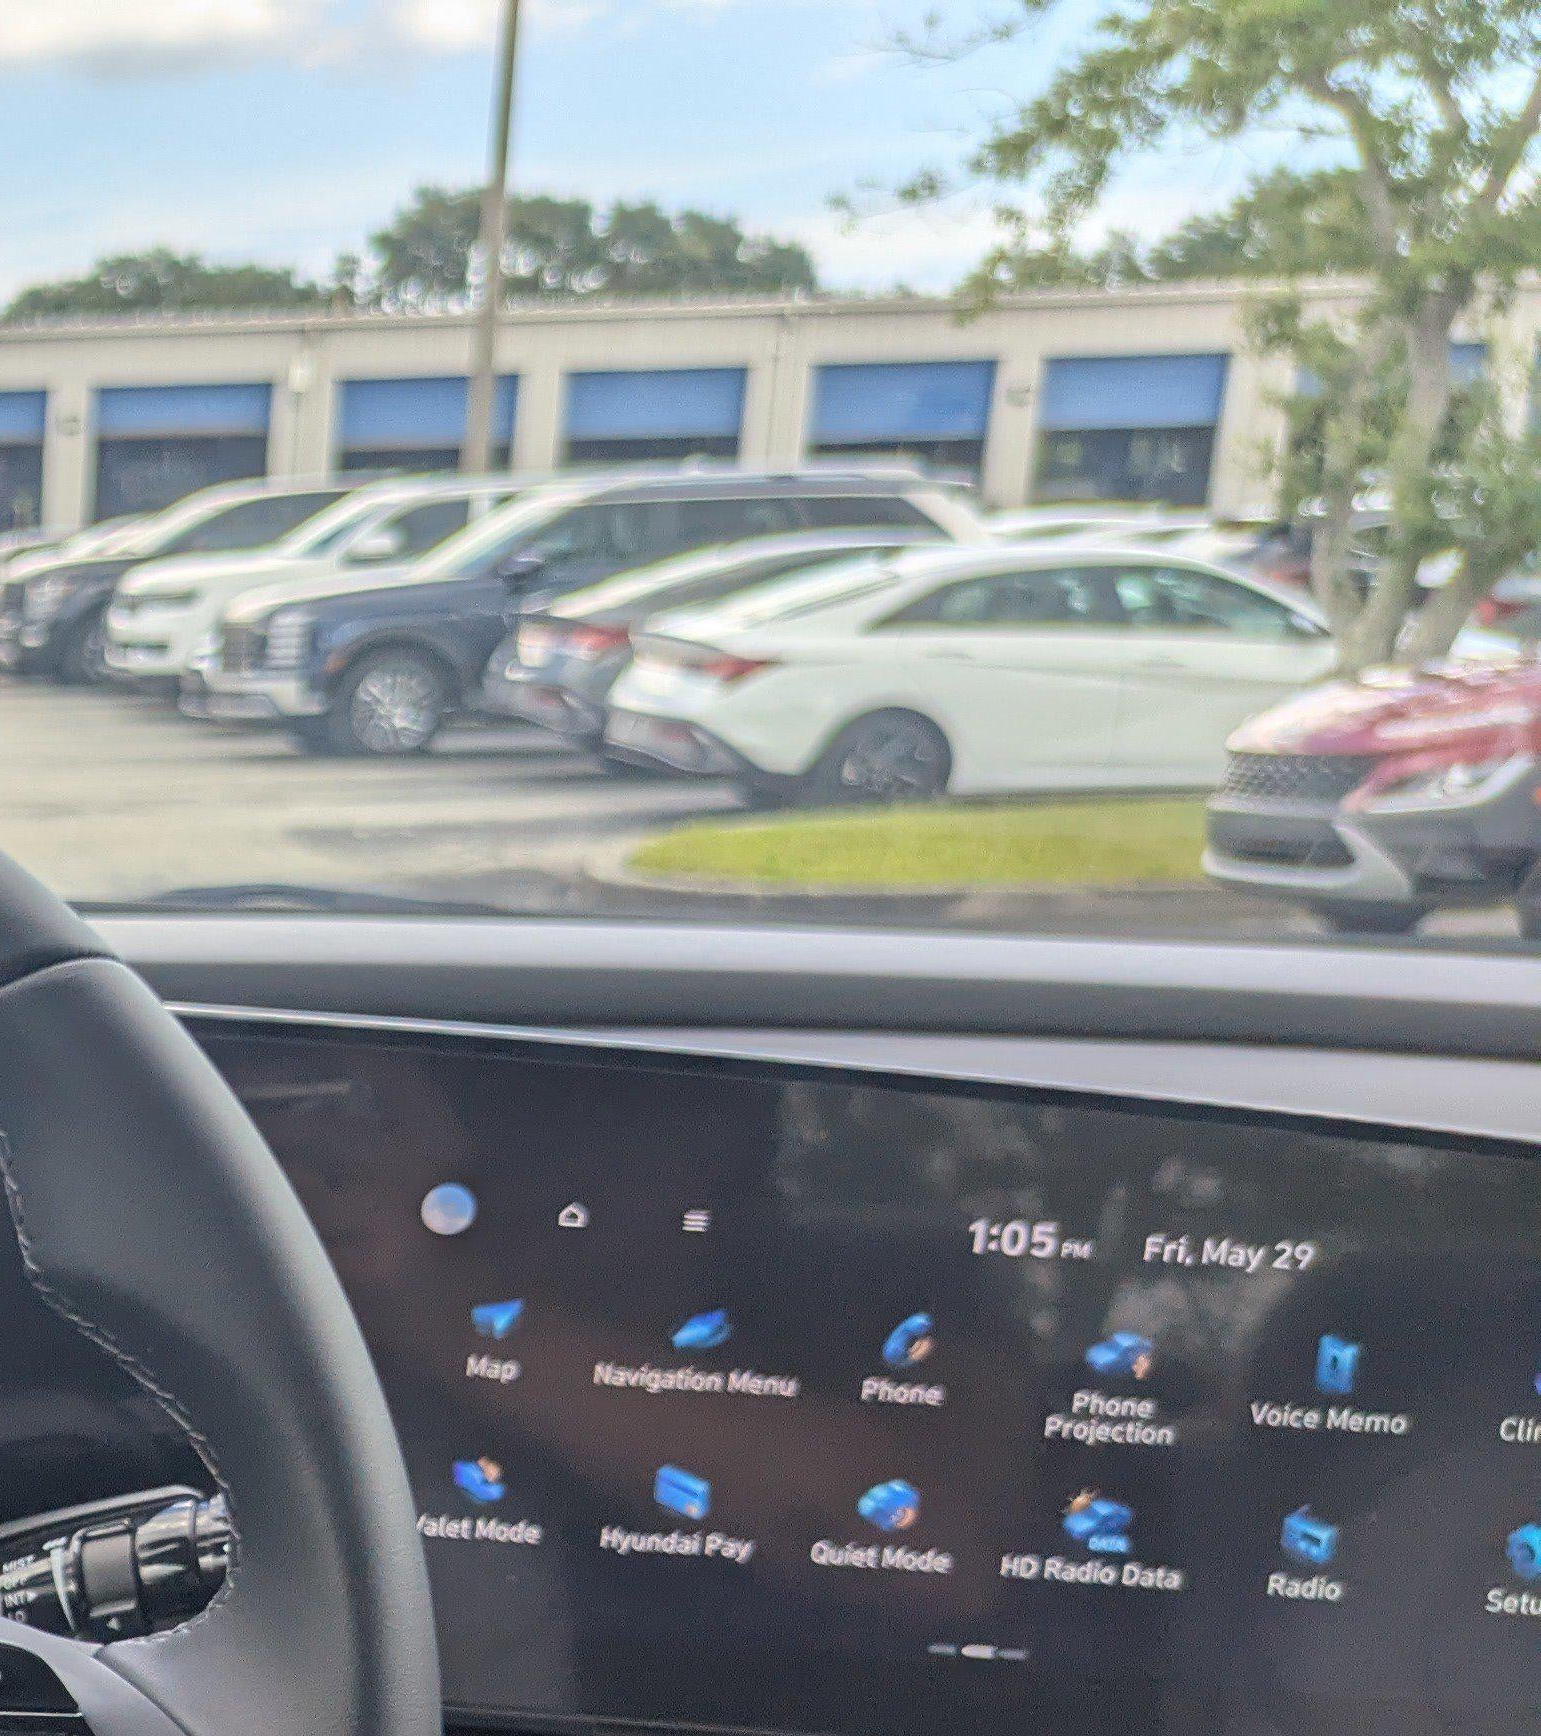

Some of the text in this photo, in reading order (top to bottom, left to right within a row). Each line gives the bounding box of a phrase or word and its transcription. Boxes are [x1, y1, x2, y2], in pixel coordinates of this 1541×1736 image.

[968, 1218, 1093, 1260] 1:05 PM
[1201, 1237, 1264, 1273] May
[1272, 1241, 1316, 1270] 29
[465, 1357, 520, 1384] Map
[593, 1363, 799, 1397] Navigation Menu
[861, 1376, 946, 1405] Phone
[1071, 1390, 1157, 1418] Phone
[1043, 1413, 1176, 1446] Projection
[1250, 1401, 1410, 1435] Voice Memo
[475, 1516, 542, 1545] Mode
[600, 1525, 754, 1565] Hyundai Pay
[810, 1539, 953, 1574] Quiet Mode
[1000, 1553, 1183, 1591] HD Radio Data
[1267, 1572, 1343, 1601] Radio
